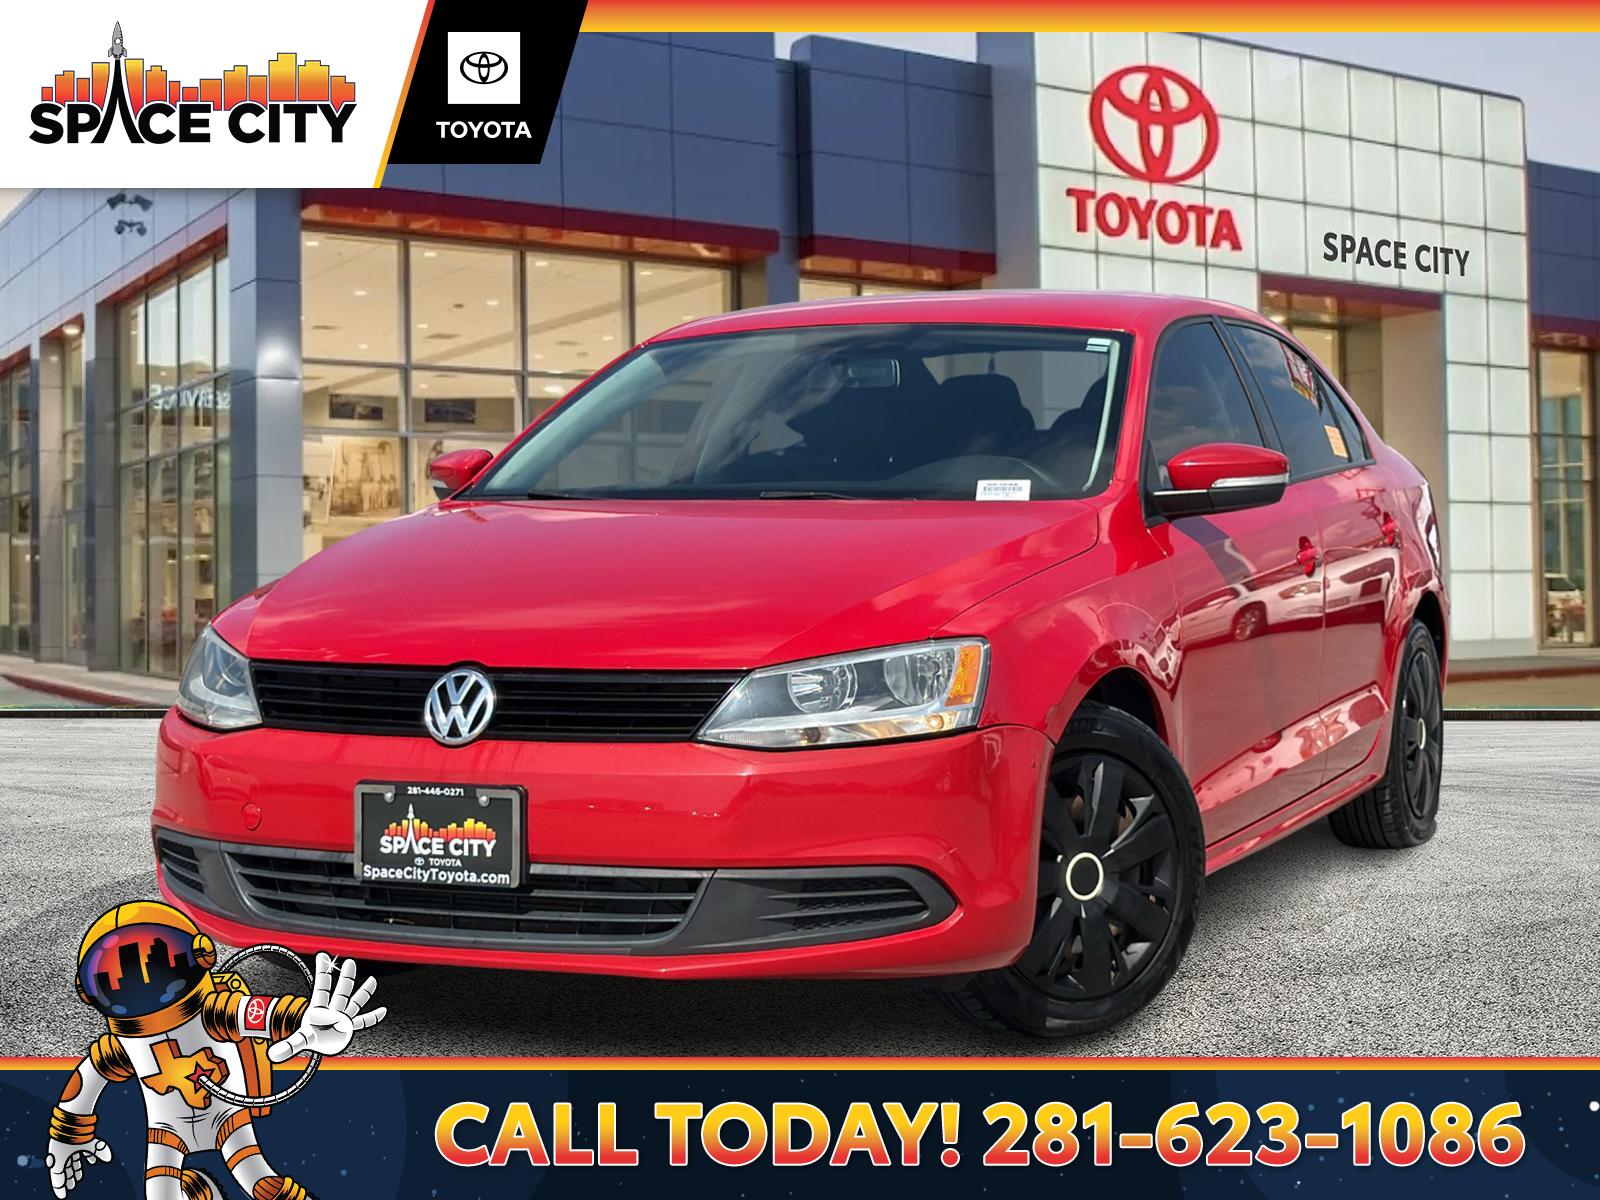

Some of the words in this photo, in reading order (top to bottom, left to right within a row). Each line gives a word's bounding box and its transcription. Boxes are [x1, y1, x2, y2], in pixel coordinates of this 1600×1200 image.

[1066, 187, 1243, 251] TOYOTA
[1322, 232, 1407, 270] SPACE
[1414, 245, 1470, 277] CITY
[407, 786, 465, 797] 281-446-0271
[379, 831, 444, 855] SPACE
[448, 838, 497, 858] CITY
[429, 857, 462, 867] TOYOTA
[363, 864, 510, 885] SpaceCityToyota.com
